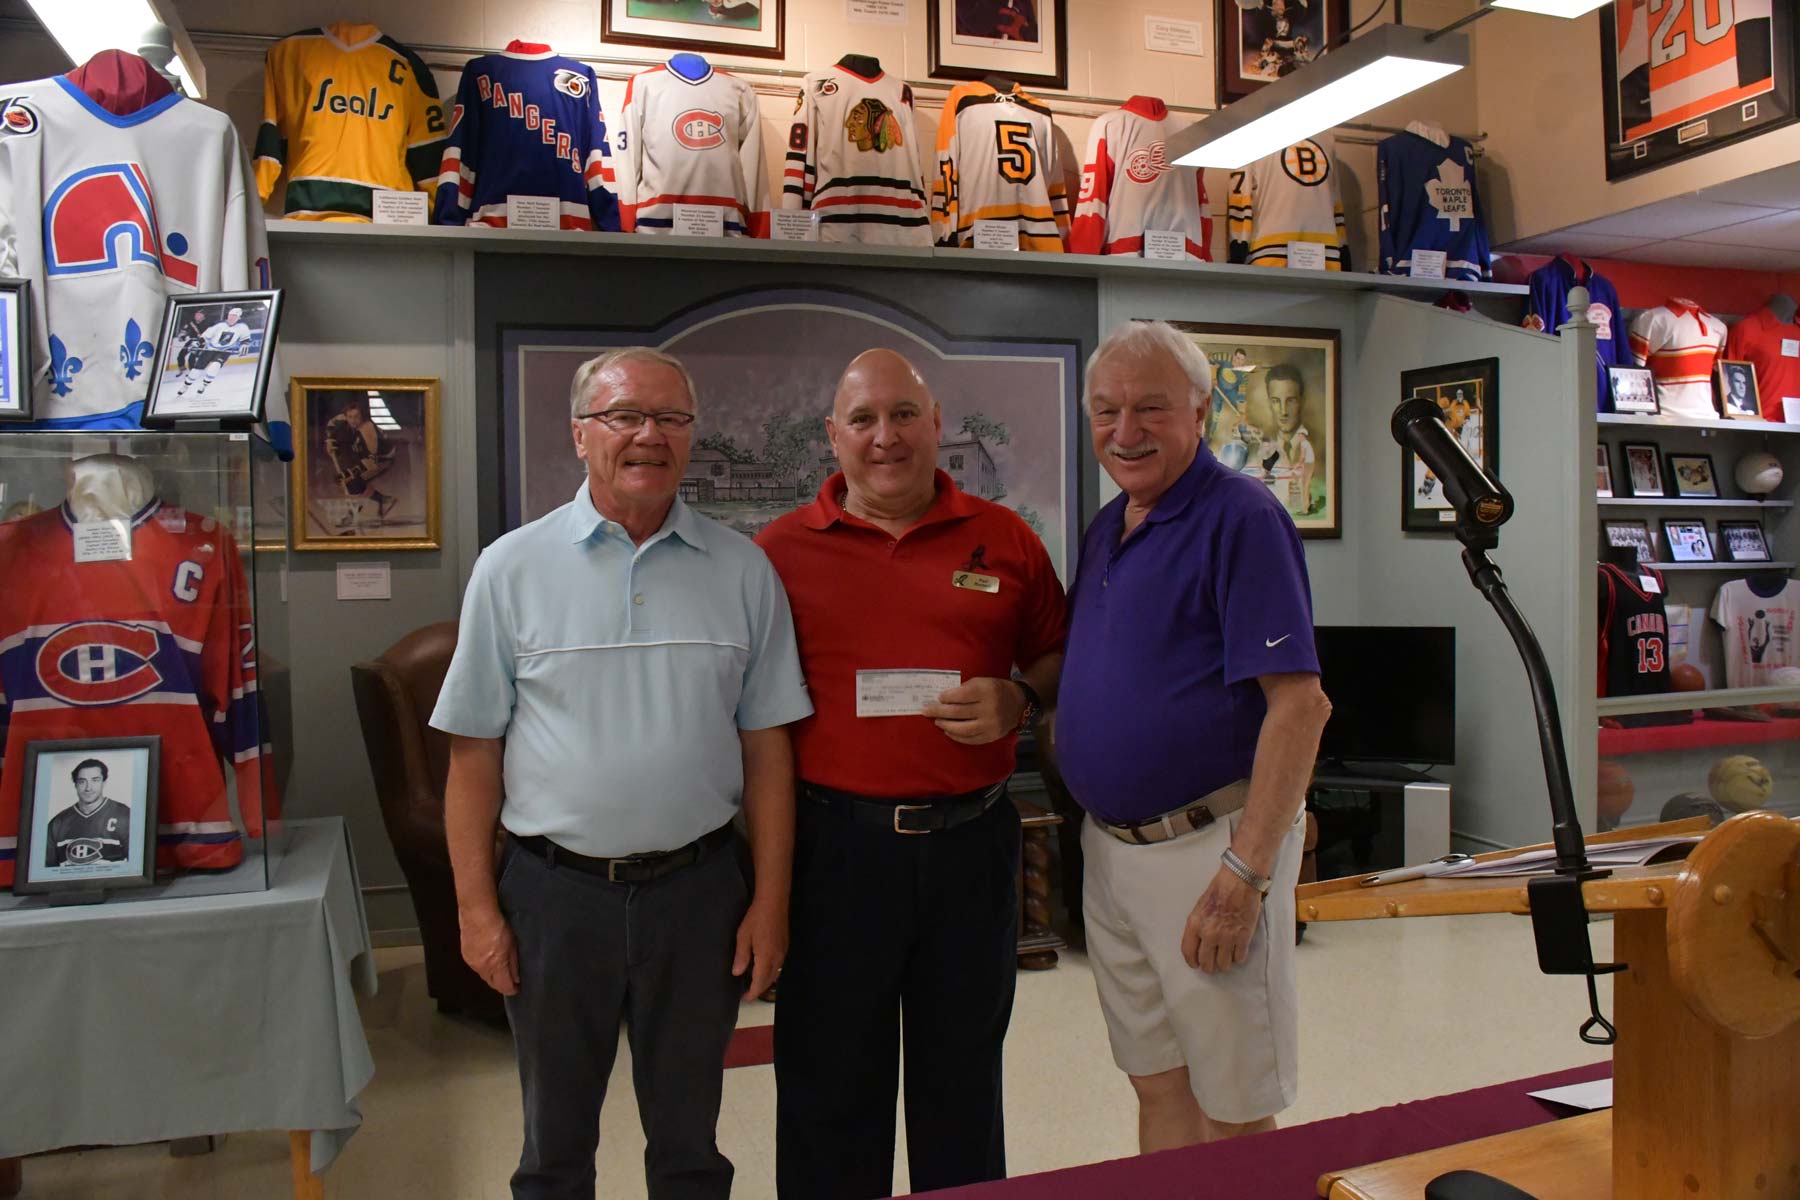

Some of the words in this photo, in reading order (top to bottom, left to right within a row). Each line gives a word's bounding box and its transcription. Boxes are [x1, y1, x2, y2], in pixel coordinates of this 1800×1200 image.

[1649, 0, 1735, 69] 20
[389, 59, 407, 86] C
[312, 78, 394, 121] Seals
[476, 74, 582, 174] RANGERS
[995, 120, 1037, 186] 5
[1295, 147, 1318, 176] B
[1230, 170, 1246, 195] 7
[1442, 195, 1468, 204] MAPLE
[1443, 204, 1467, 213] LEAFS
[171, 560, 205, 604] C
[1637, 637, 1665, 674] 13
